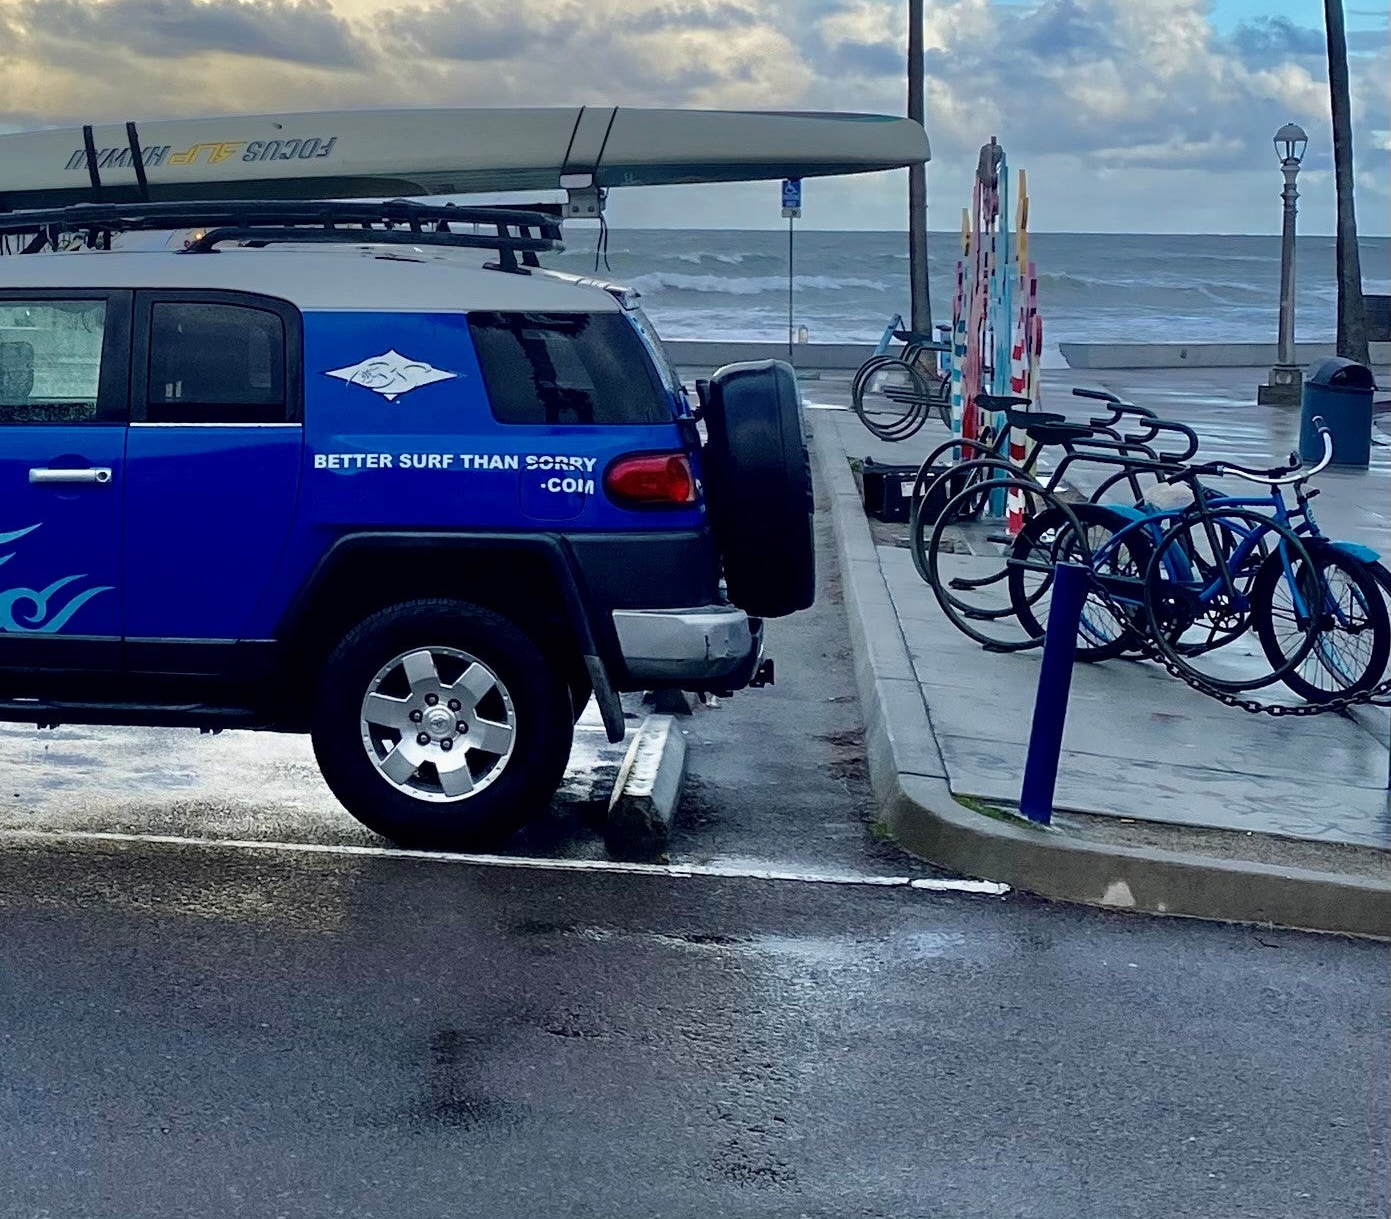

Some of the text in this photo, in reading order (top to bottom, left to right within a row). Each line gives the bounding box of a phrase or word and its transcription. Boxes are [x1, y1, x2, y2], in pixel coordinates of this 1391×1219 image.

[243, 136, 337, 161] FOCUS
[314, 454, 597, 472] BETTER SURF THAN SORRY
